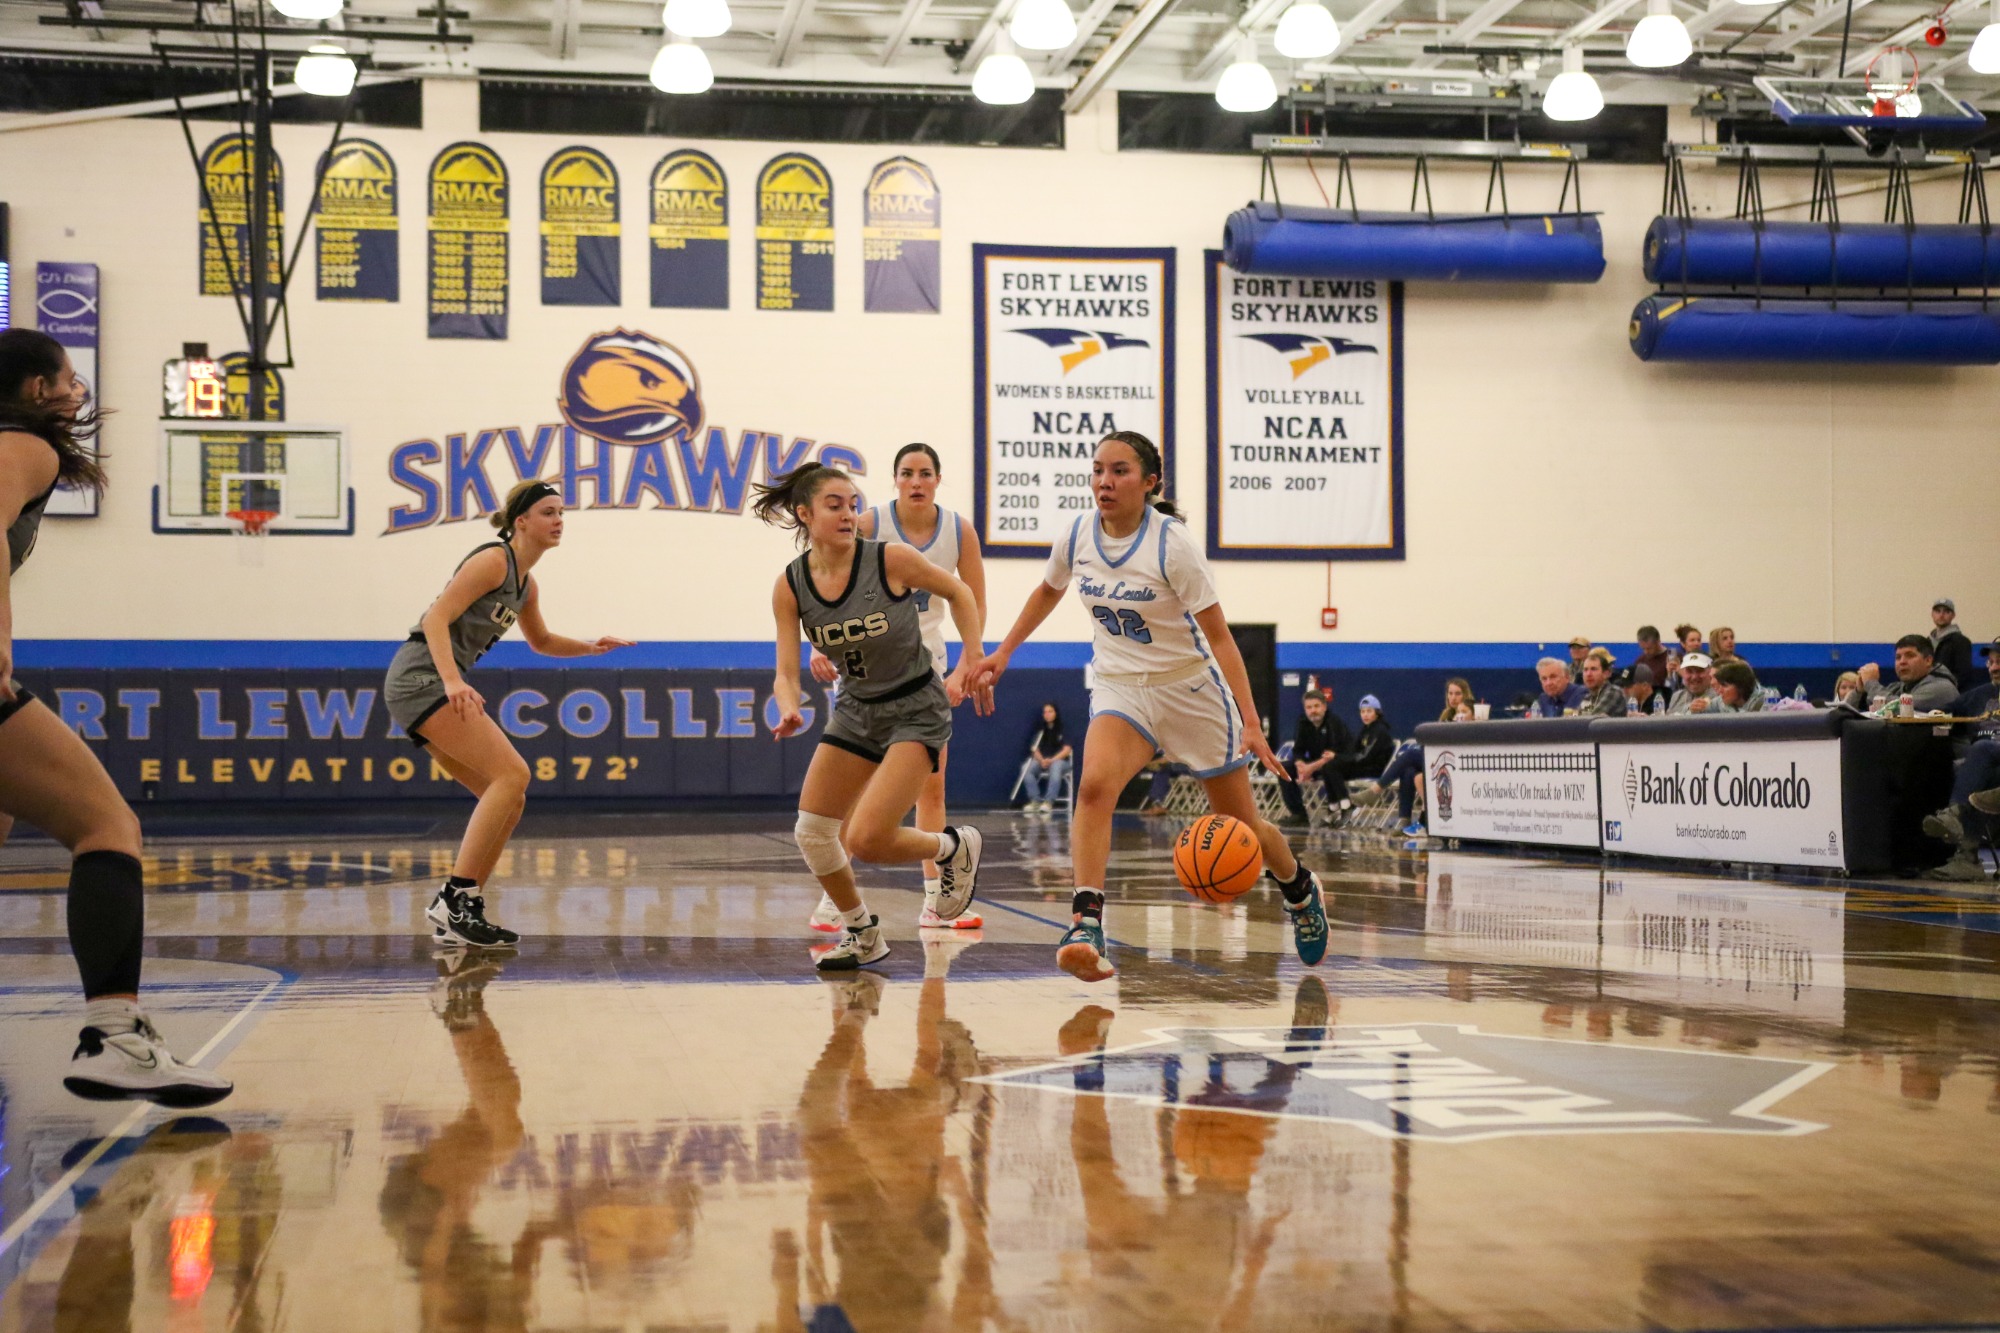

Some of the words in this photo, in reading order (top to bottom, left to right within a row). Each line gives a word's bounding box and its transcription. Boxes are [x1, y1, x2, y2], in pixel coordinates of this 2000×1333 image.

[321, 180, 393, 199] RMAC
[433, 182, 504, 203] RMAC
[545, 187, 614, 208] RMAC
[655, 190, 724, 212] RMAC
[761, 193, 829, 213] RMAC
[869, 194, 934, 213] RMAC
[1002, 273, 1060, 291] FORT
[1070, 274, 1148, 292] LEWIS
[1233, 278, 1296, 297] FORT
[1299, 280, 1376, 298] LEWIS
[1000, 298, 1150, 318] SKYHAWKS
[1231, 303, 1379, 323] SKYHAWKS
[187, 379, 221, 416] 19
[996, 384, 1062, 398] WOMEN'S
[1067, 386, 1155, 400] BASKETBALL
[1245, 389, 1365, 405] VOLLEYBALL
[1033, 411, 1117, 434] NCAA
[1264, 416, 1348, 440] NCAA
[998, 441, 1096, 459] TOURNA
[1230, 445, 1381, 464] TOURNAMENT
[997, 473, 1041, 487] 2004
[1229, 476, 1272, 490] 2006
[1284, 477, 1326, 492] 2007
[1000, 495, 1039, 509] 2010
[998, 517, 1038, 531] 2013
[1079, 575, 1105, 597] Fort
[1108, 581, 1156, 601] Lewis
[805, 611, 890, 648] UCCS
[844, 649, 868, 679] 2
[499, 688, 838, 739] COLLEG
[140, 757, 453, 783] ELEVATION
[1471, 782, 1482, 799] Go
[1483, 783, 1519, 803] Skyhawks!
[1520, 784, 1531, 799] On
[1533, 783, 1551, 800] track
[1554, 786, 1561, 800] to
[1564, 784, 1585, 801] WIN!
[1641, 762, 1685, 805] Bank
[1690, 761, 1709, 806] of
[1714, 761, 1811, 809] Colorado
[1201, 814, 1225, 850] ilson
[1676, 823, 1747, 841] bankofcolorado.com
